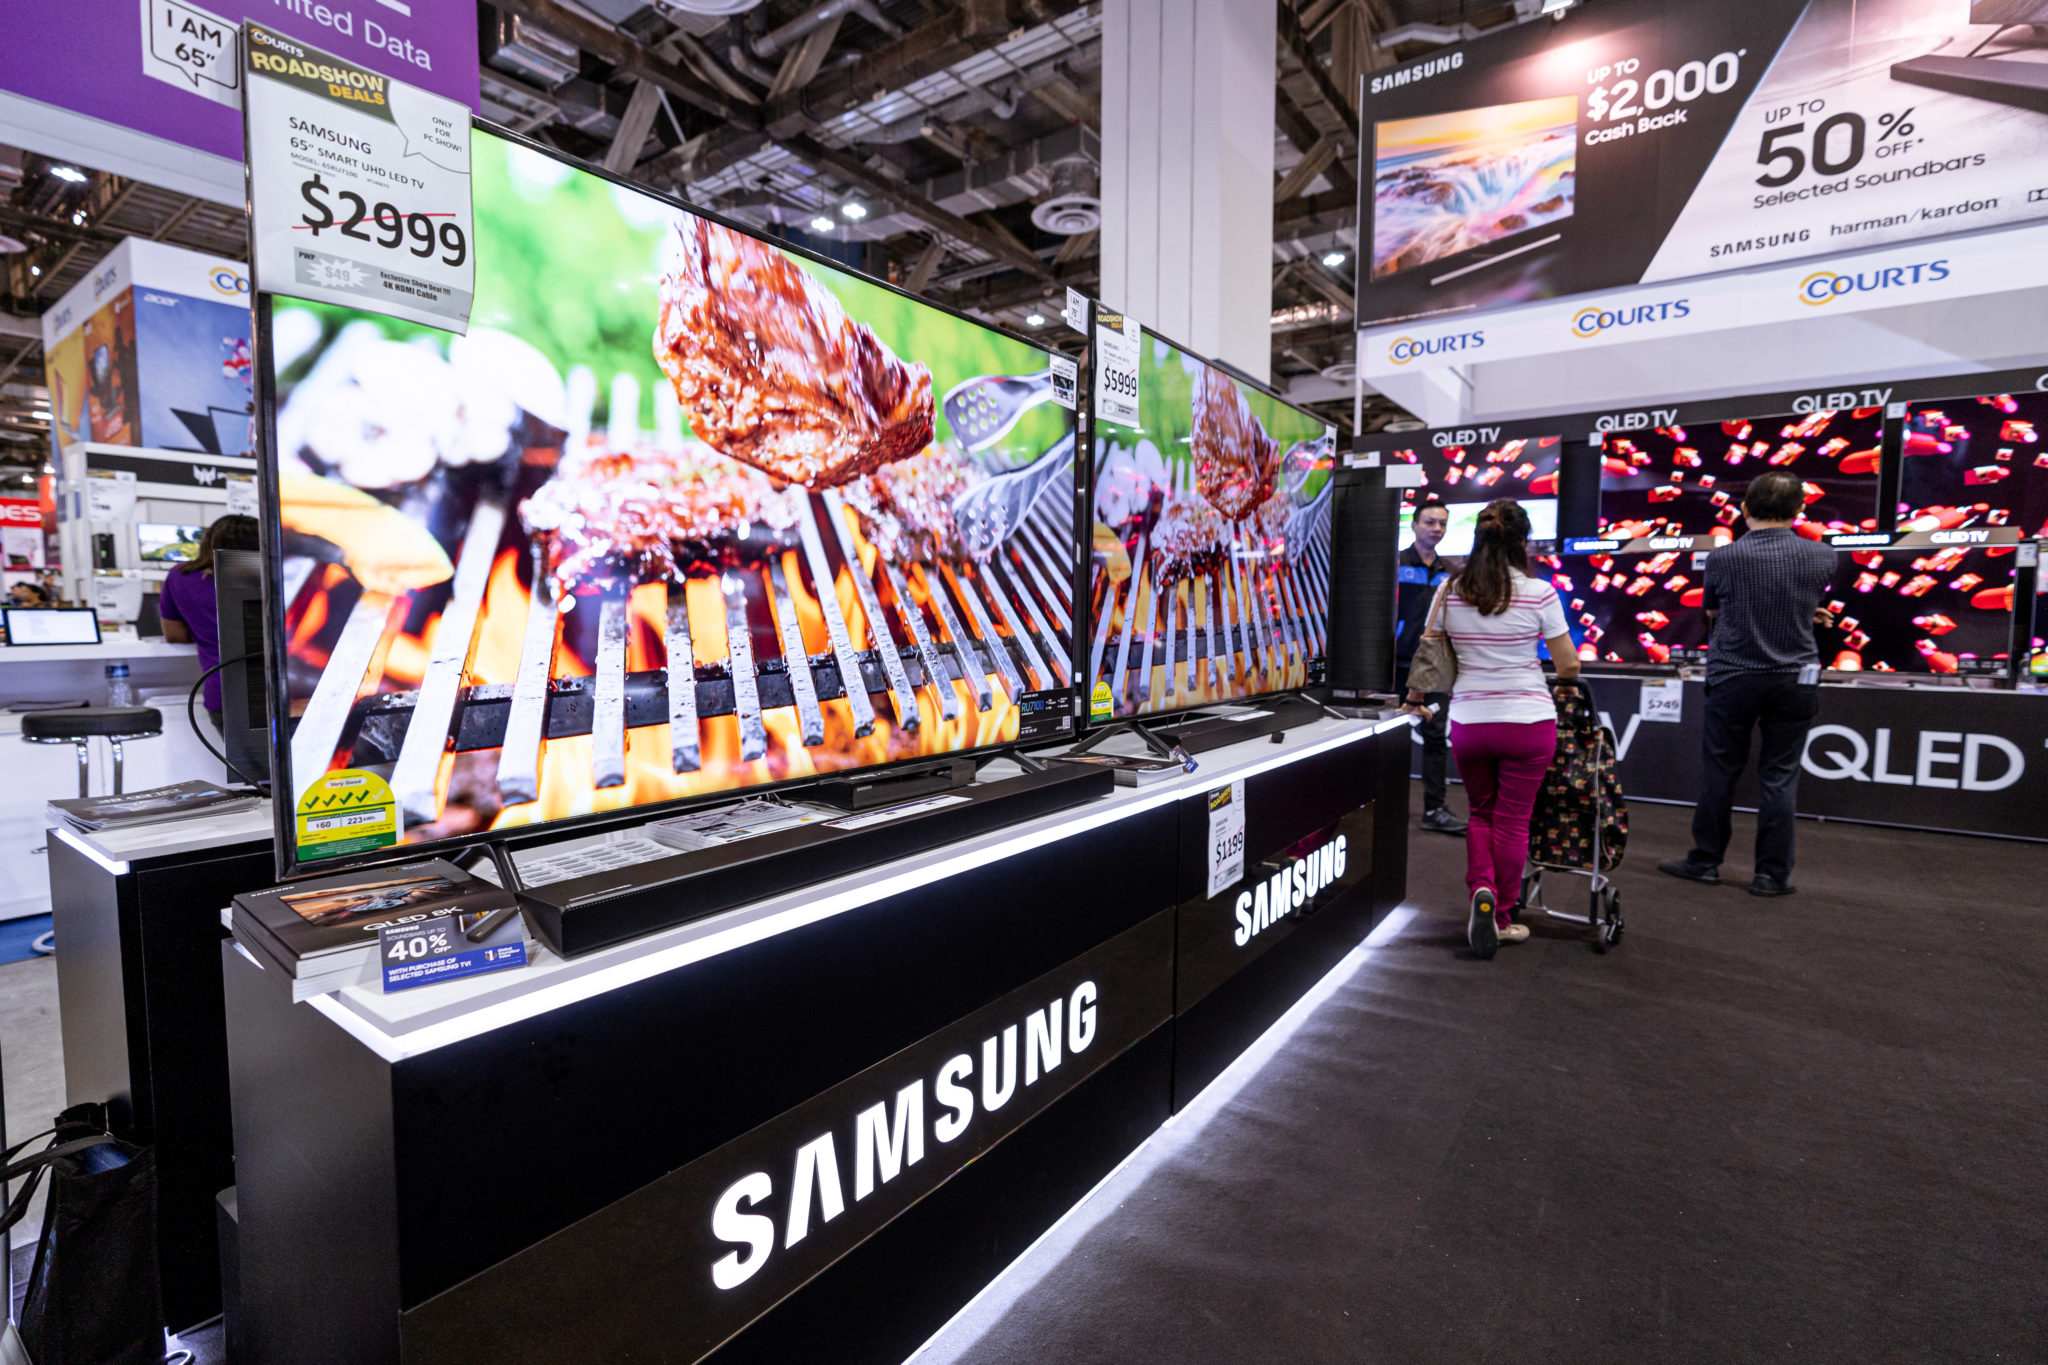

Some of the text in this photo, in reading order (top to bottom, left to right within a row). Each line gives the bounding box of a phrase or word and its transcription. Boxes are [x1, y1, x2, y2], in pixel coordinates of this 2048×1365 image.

[167, 8, 221, 48] I AM
[175, 42, 215, 68] 65"
[251, 29, 304, 58] COURTS
[364, 19, 432, 71] Data
[251, 51, 384, 92] ROADSHOW
[1371, 52, 1463, 94] SAMSUNG
[1587, 58, 1640, 84] UP TO
[328, 83, 385, 106] DEALS
[432, 116, 453, 129] ONLY
[1765, 99, 1825, 124] UP TO
[289, 116, 372, 155] SAMSUNG
[434, 127, 450, 139] FOR
[1585, 108, 1688, 146] Cash Back
[423, 134, 463, 153] PC SHOW!
[317, 147, 359, 168] SMART
[361, 162, 386, 178] UHD
[389, 172, 408, 184] LED
[411, 178, 425, 190] TV
[1753, 152, 1986, 209] Selected Soundbars
[301, 173, 467, 267] $2999
[1710, 229, 1811, 258] SAMSUNG
[383, 280, 438, 302] 4K HDMI Cable
[1802, 259, 1950, 303] COURTS
[143, 292, 180, 307] acer
[1575, 299, 1691, 335] COURTS
[1391, 330, 1485, 363] COURTS
[1104, 363, 1137, 398] $5999
[1792, 388, 1892, 415] QLED TV
[1595, 409, 1677, 433] QLED TV
[1432, 427, 1500, 448] QLED TV
[1802, 723, 2026, 792] QLED
[1215, 832, 1243, 866] $1199
[1234, 834, 1347, 947] SAMSUNG
[362, 905, 464, 931] QLED 8K
[385, 924, 419, 935] SAMSUNG
[386, 930, 426, 942] SOUNDBARS
[426, 928, 436, 936] UP
[388, 957, 457, 976] WITH PURCHASE OF
[388, 971, 424, 982] SELECTED
[424, 964, 459, 976] SAMSUNG
[711, 980, 1097, 1290] SAMSUNG
